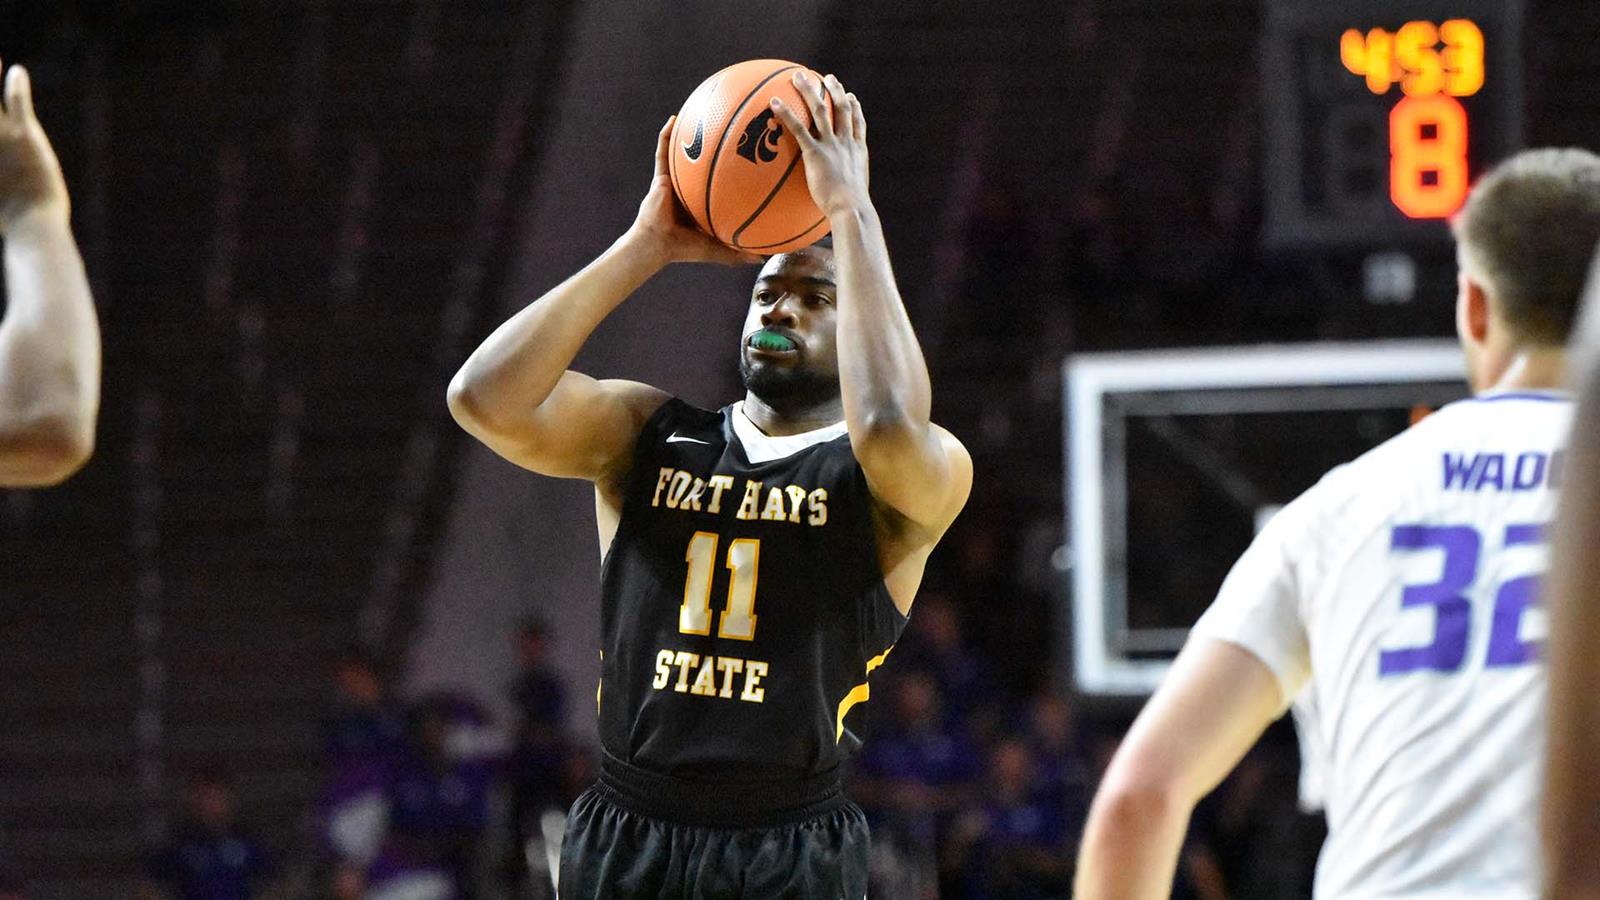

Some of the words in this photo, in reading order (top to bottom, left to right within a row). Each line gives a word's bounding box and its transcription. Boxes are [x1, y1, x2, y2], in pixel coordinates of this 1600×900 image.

[1389, 95, 1468, 219] 8
[652, 467, 734, 514] FORT
[736, 479, 828, 526] HAYS
[679, 530, 760, 641] 11
[1378, 522, 1551, 679] 32
[652, 649, 769, 703] STATE
